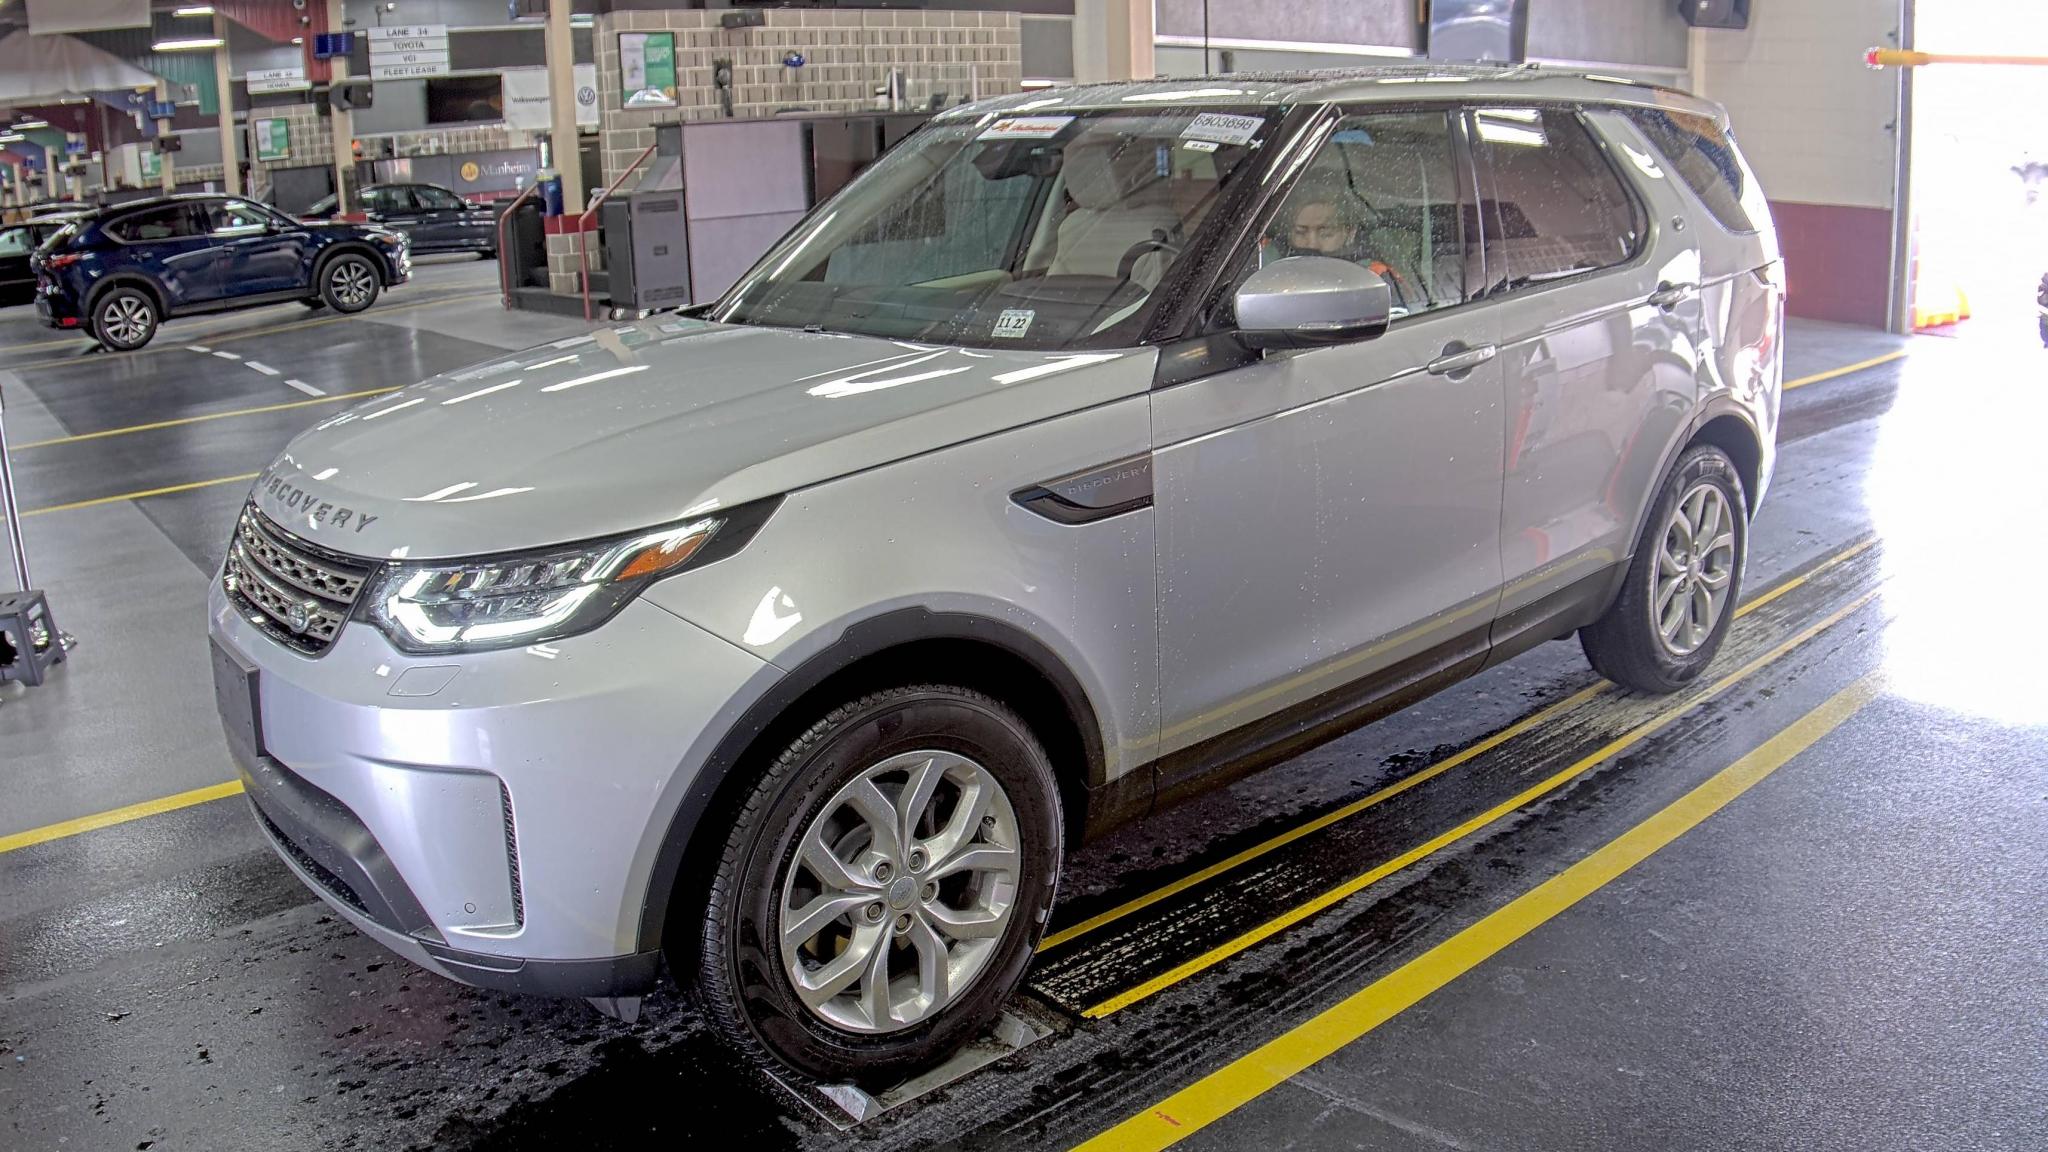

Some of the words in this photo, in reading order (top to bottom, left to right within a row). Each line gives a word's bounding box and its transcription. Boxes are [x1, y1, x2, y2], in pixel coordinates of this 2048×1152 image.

[386, 29, 409, 37] LANE
[393, 41, 425, 50] TOYOTA
[384, 67, 408, 76] FLEET
[411, 66, 436, 74] LEASE
[480, 161, 531, 176] Manheim
[997, 317, 1011, 328] 11
[1012, 317, 1027, 328] 22
[1068, 458, 1151, 495] DISCOVERY
